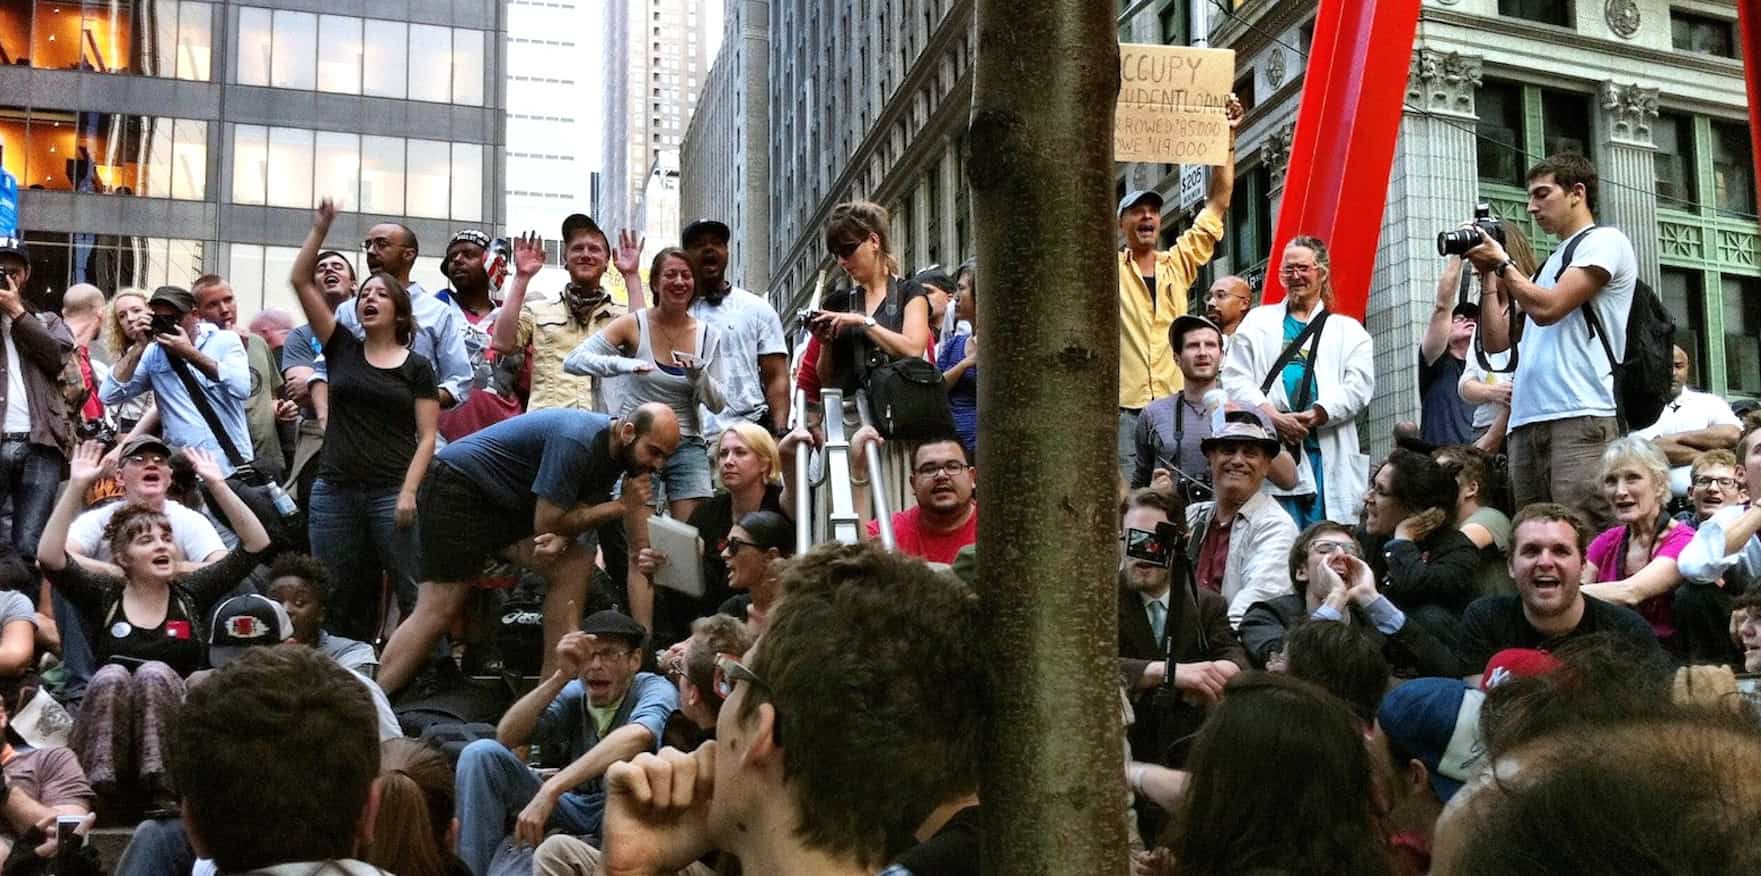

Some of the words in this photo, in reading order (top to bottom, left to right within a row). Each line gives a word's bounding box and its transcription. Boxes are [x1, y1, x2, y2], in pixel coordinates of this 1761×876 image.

[1122, 53, 1202, 84] CCUPY
[1116, 117, 1173, 135] ROWED
[1182, 167, 1202, 193] $205
[517, 612, 544, 625] asic
